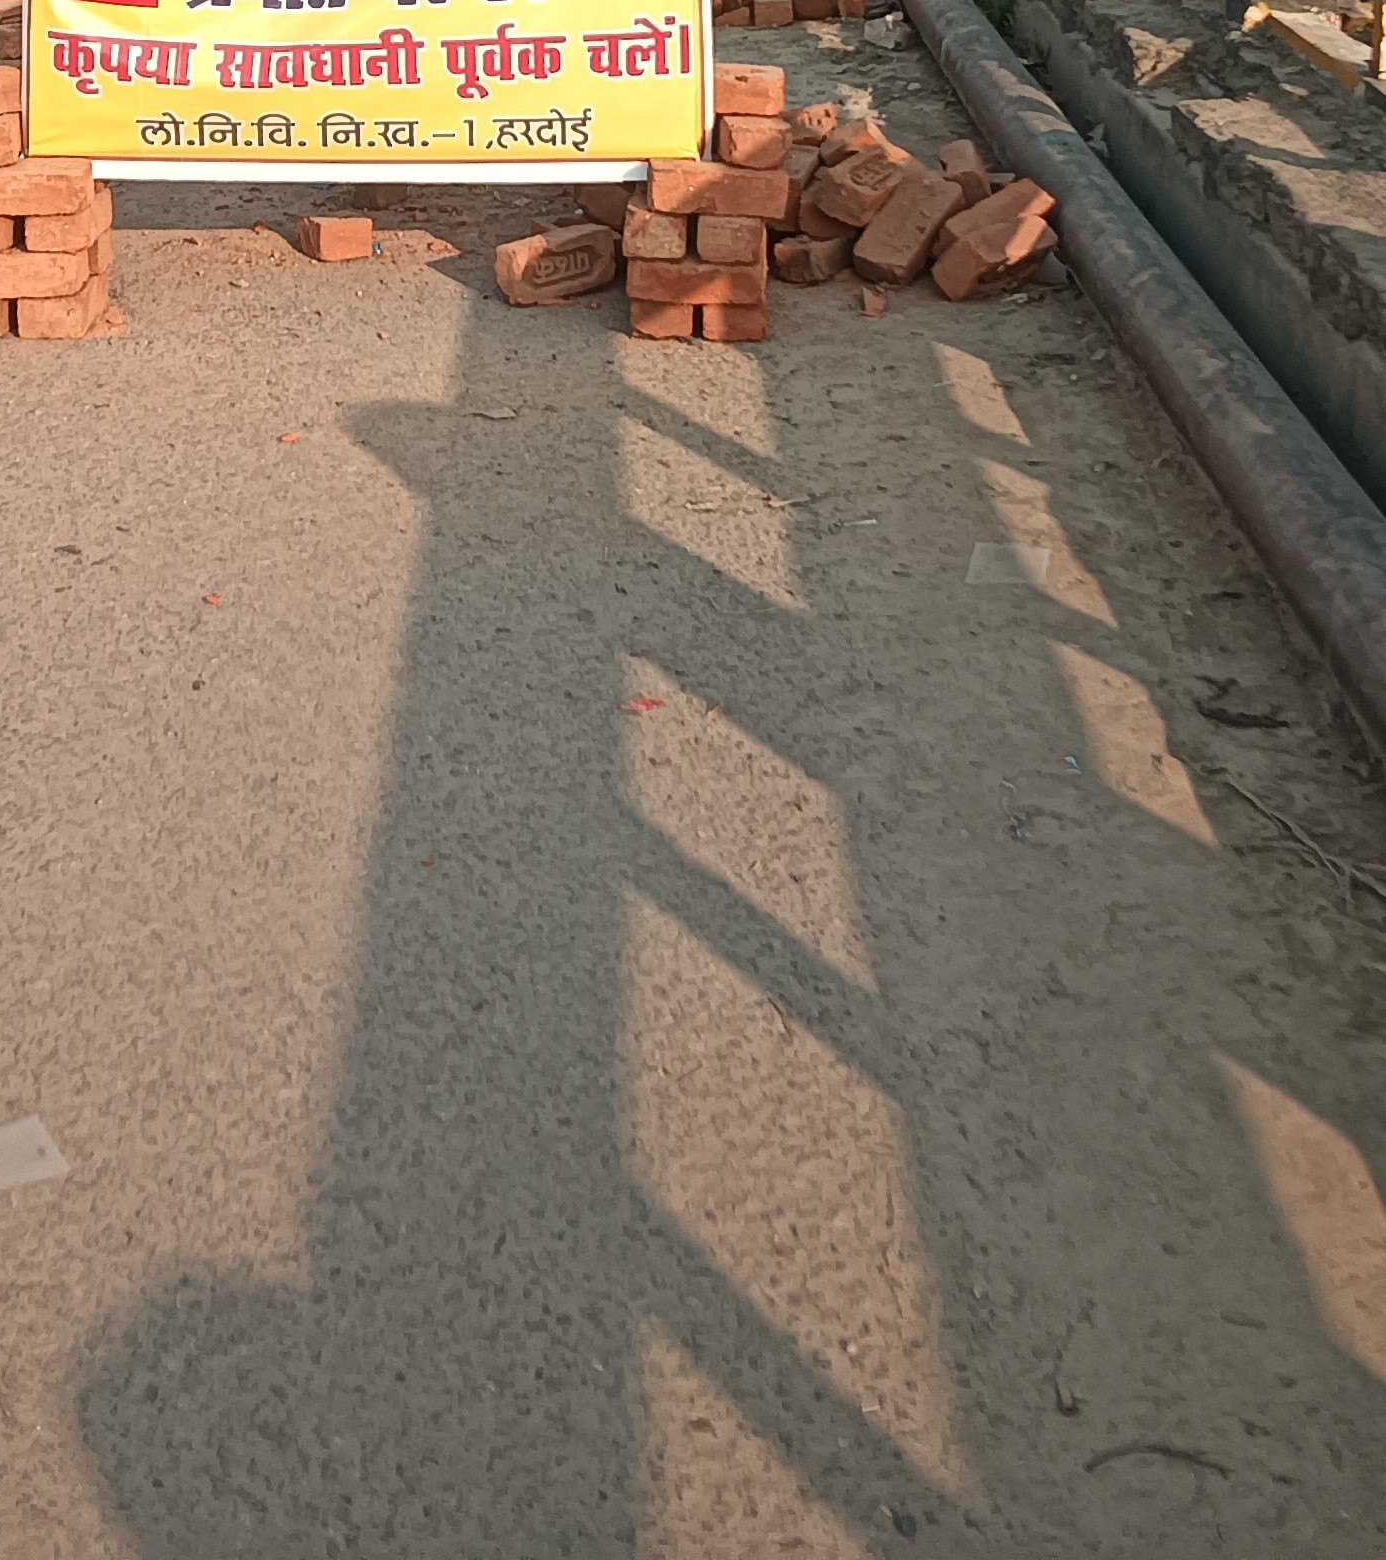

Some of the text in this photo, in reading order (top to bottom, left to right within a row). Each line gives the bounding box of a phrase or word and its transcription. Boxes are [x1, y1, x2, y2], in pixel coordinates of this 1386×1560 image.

[48, 30, 197, 95] कृपया
[213, 29, 425, 89] सावधानी
[440, 22, 567, 99] पूर्वक
